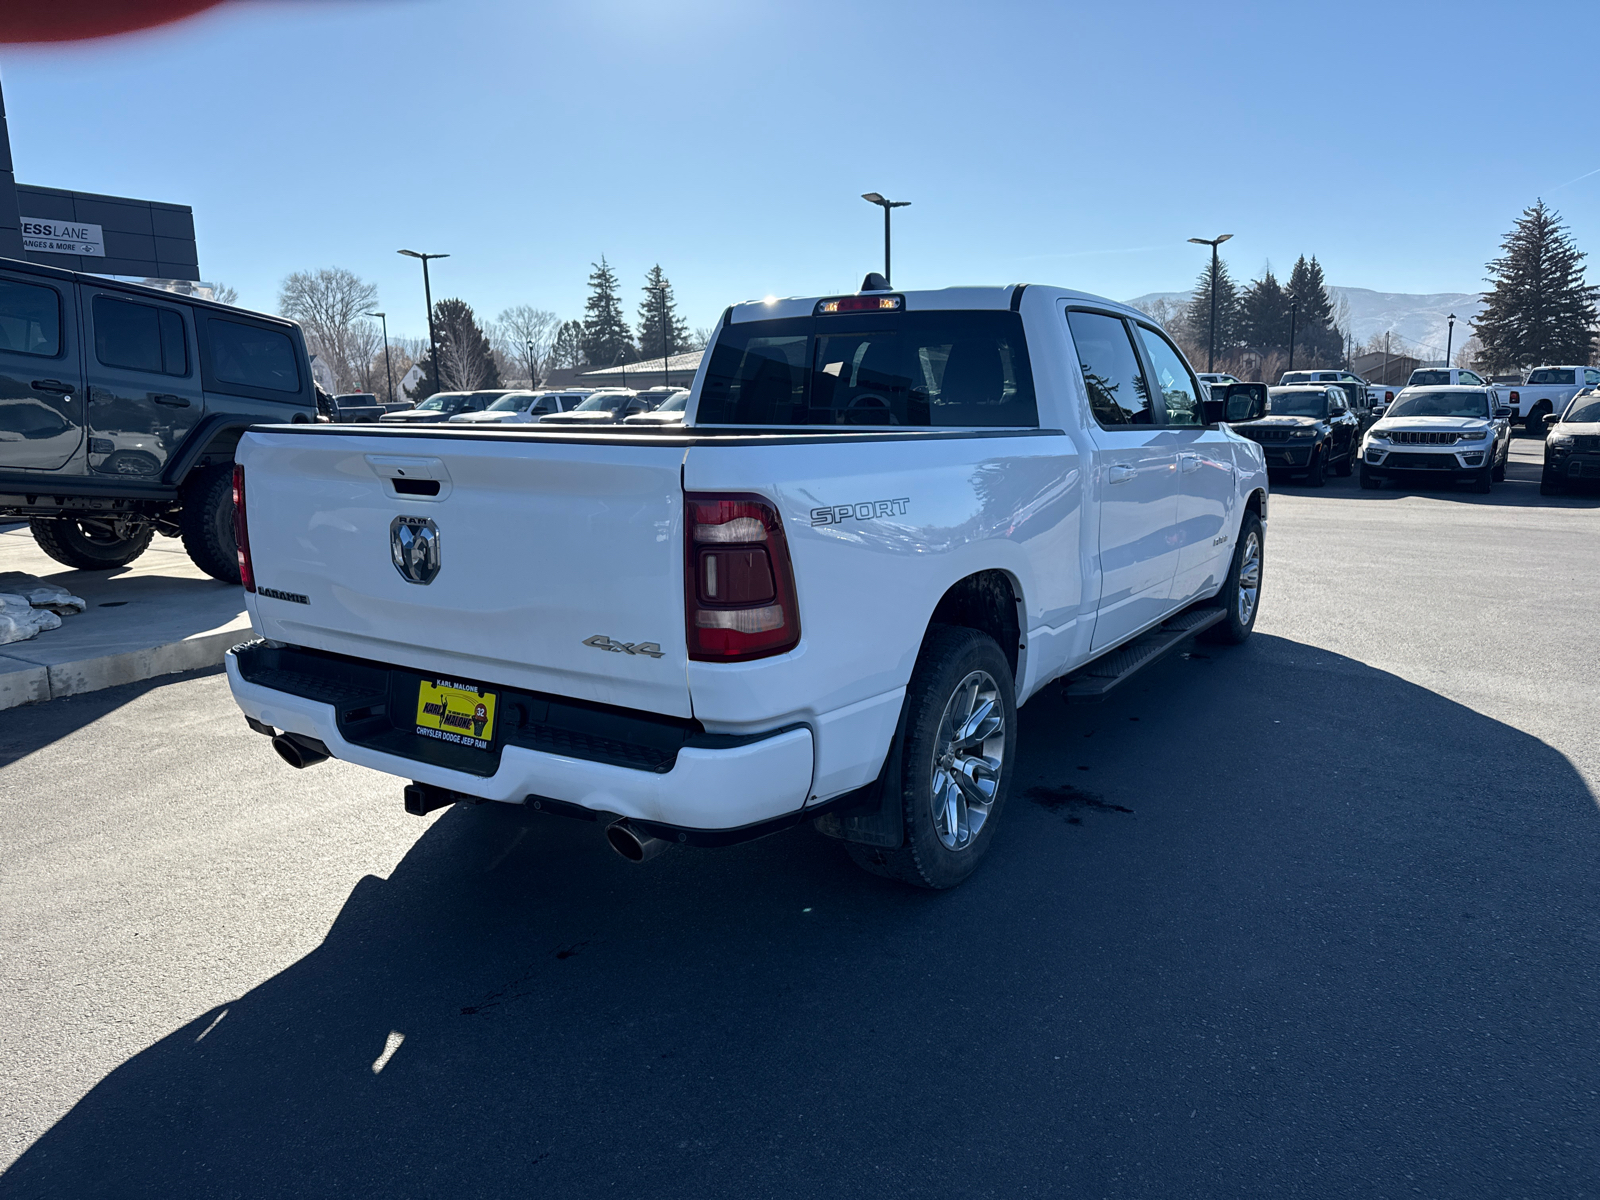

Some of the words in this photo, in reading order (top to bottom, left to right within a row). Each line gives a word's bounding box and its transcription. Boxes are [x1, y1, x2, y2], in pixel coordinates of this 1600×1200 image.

[55, 242, 76, 251] MORE
[810, 497, 910, 527] SPORT
[398, 517, 427, 525] RAM
[257, 586, 310, 605] LARAMIE
[436, 679, 452, 688] KARL
[453, 683, 478, 693] MALONE
[476, 708, 485, 717] 32
[443, 714, 473, 730] MALONE
[416, 726, 442, 740] CHRYSLER
[442, 733, 460, 743] DODGE
[461, 737, 474, 746] JEEP
[475, 739, 487, 749] RAM
